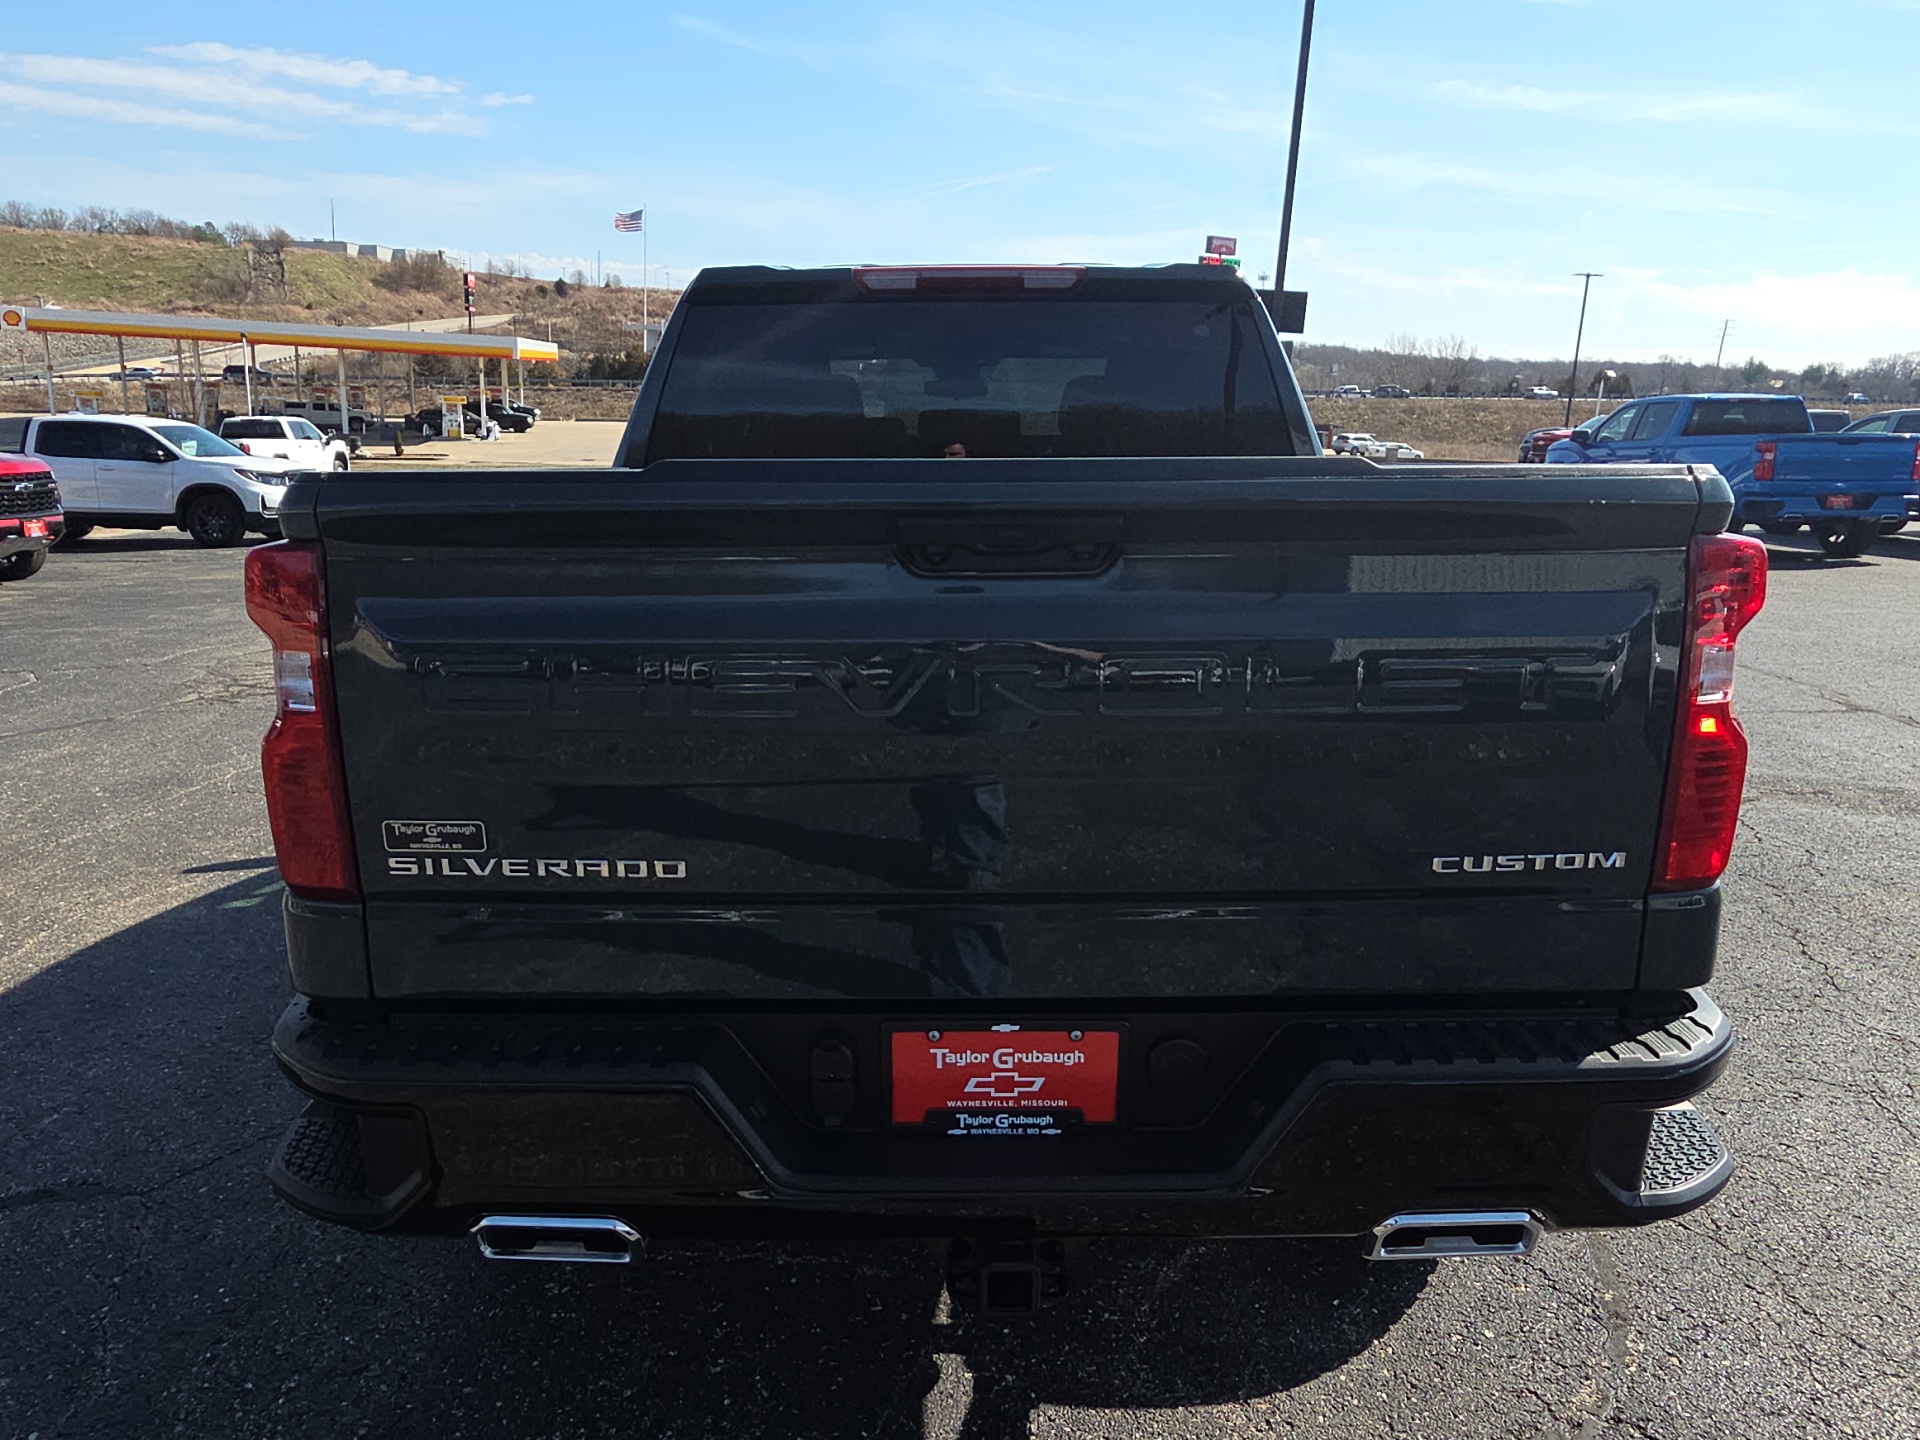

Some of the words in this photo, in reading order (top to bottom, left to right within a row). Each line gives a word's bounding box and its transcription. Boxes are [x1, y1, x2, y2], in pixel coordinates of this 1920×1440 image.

[418, 652, 1612, 716] CHEVROLET
[391, 823, 423, 836] Taylor
[425, 823, 476, 836] Grubaugh
[387, 857, 687, 879] SILVERADO
[1432, 851, 1627, 873] CUSTOM
[929, 1048, 990, 1069] Taylor
[992, 1048, 1085, 1069] Grubaugh
[946, 1100, 1018, 1108] WAYNESVILLE,
[1020, 1099, 1069, 1108] MISSOURI
[955, 1113, 995, 1128] Taylor
[995, 1113, 1054, 1128] Grubaugh
